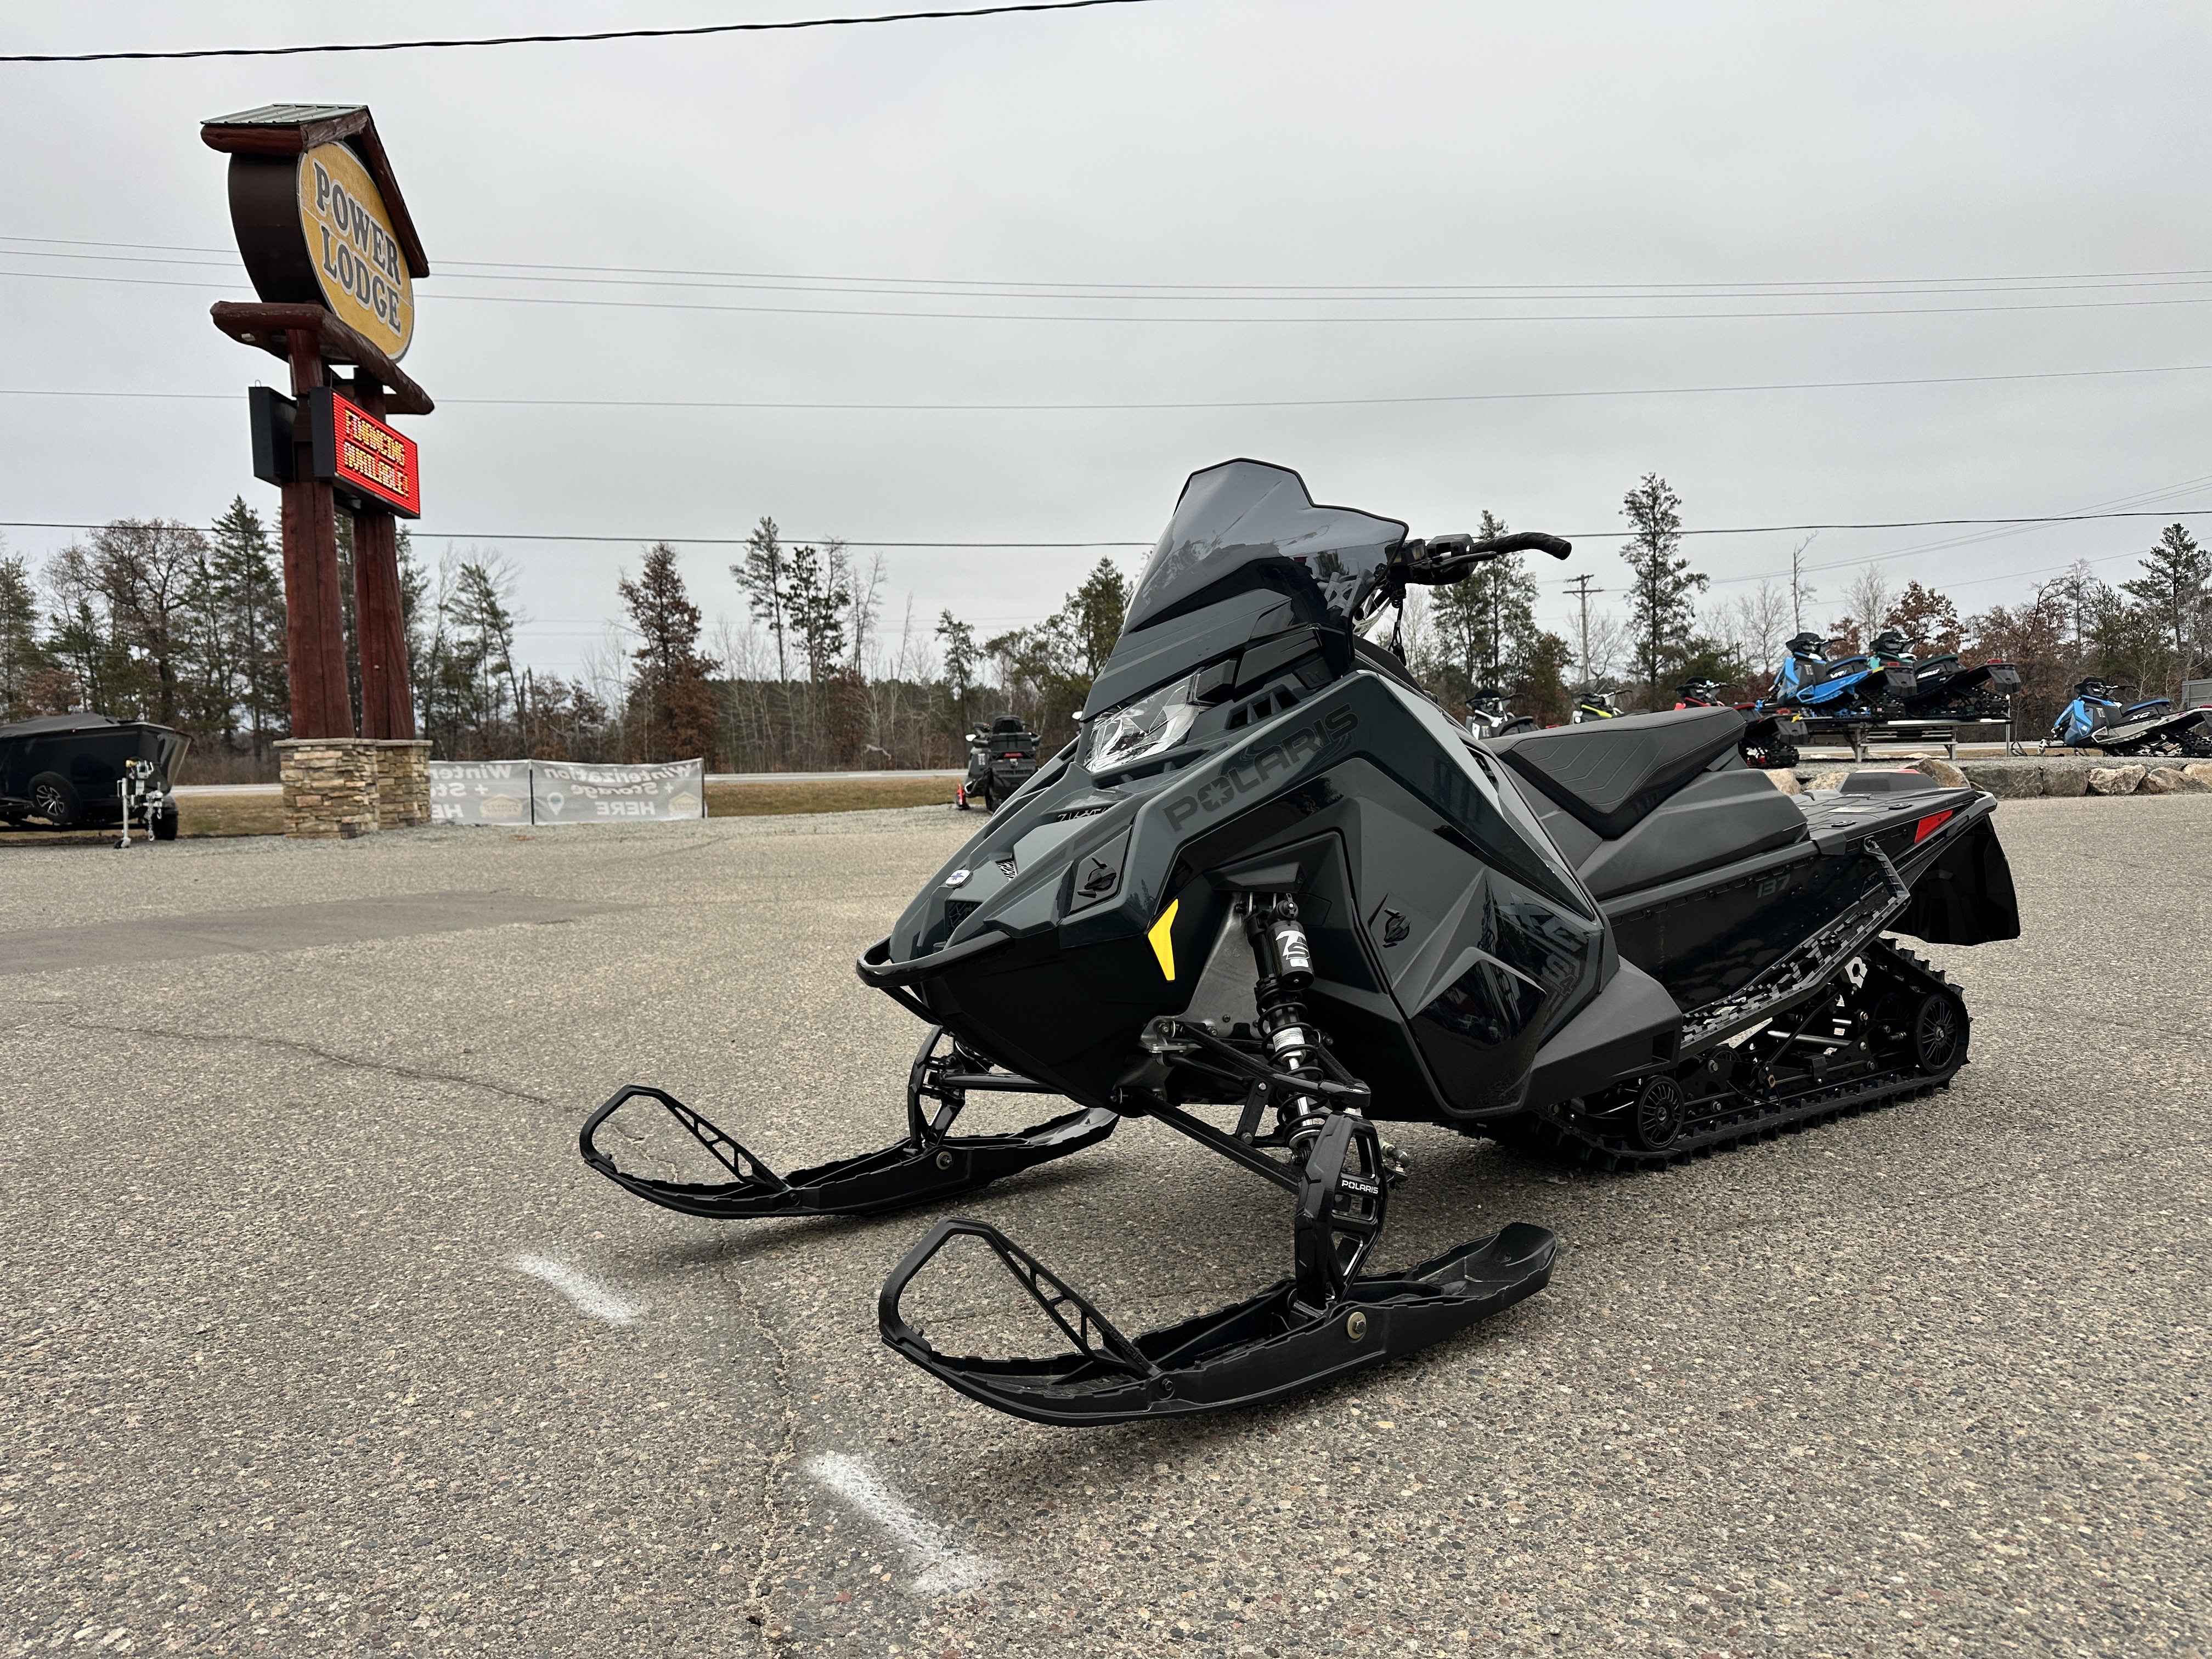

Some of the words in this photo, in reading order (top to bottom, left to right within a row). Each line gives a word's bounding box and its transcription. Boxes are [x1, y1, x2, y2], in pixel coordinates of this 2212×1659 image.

[313, 159, 402, 287] POWER
[320, 222, 402, 336] LODGE
[345, 410, 405, 466] FINANCING
[343, 442, 409, 497] AVAILABLE!
[1917, 668, 1940, 679] ASSAULT
[1163, 702, 1359, 832] POLARIS
[1757, 873, 1791, 899] 137
[1341, 1180, 1379, 1194] POLARIS
[1105, 1322, 1145, 1364] POLARIS
